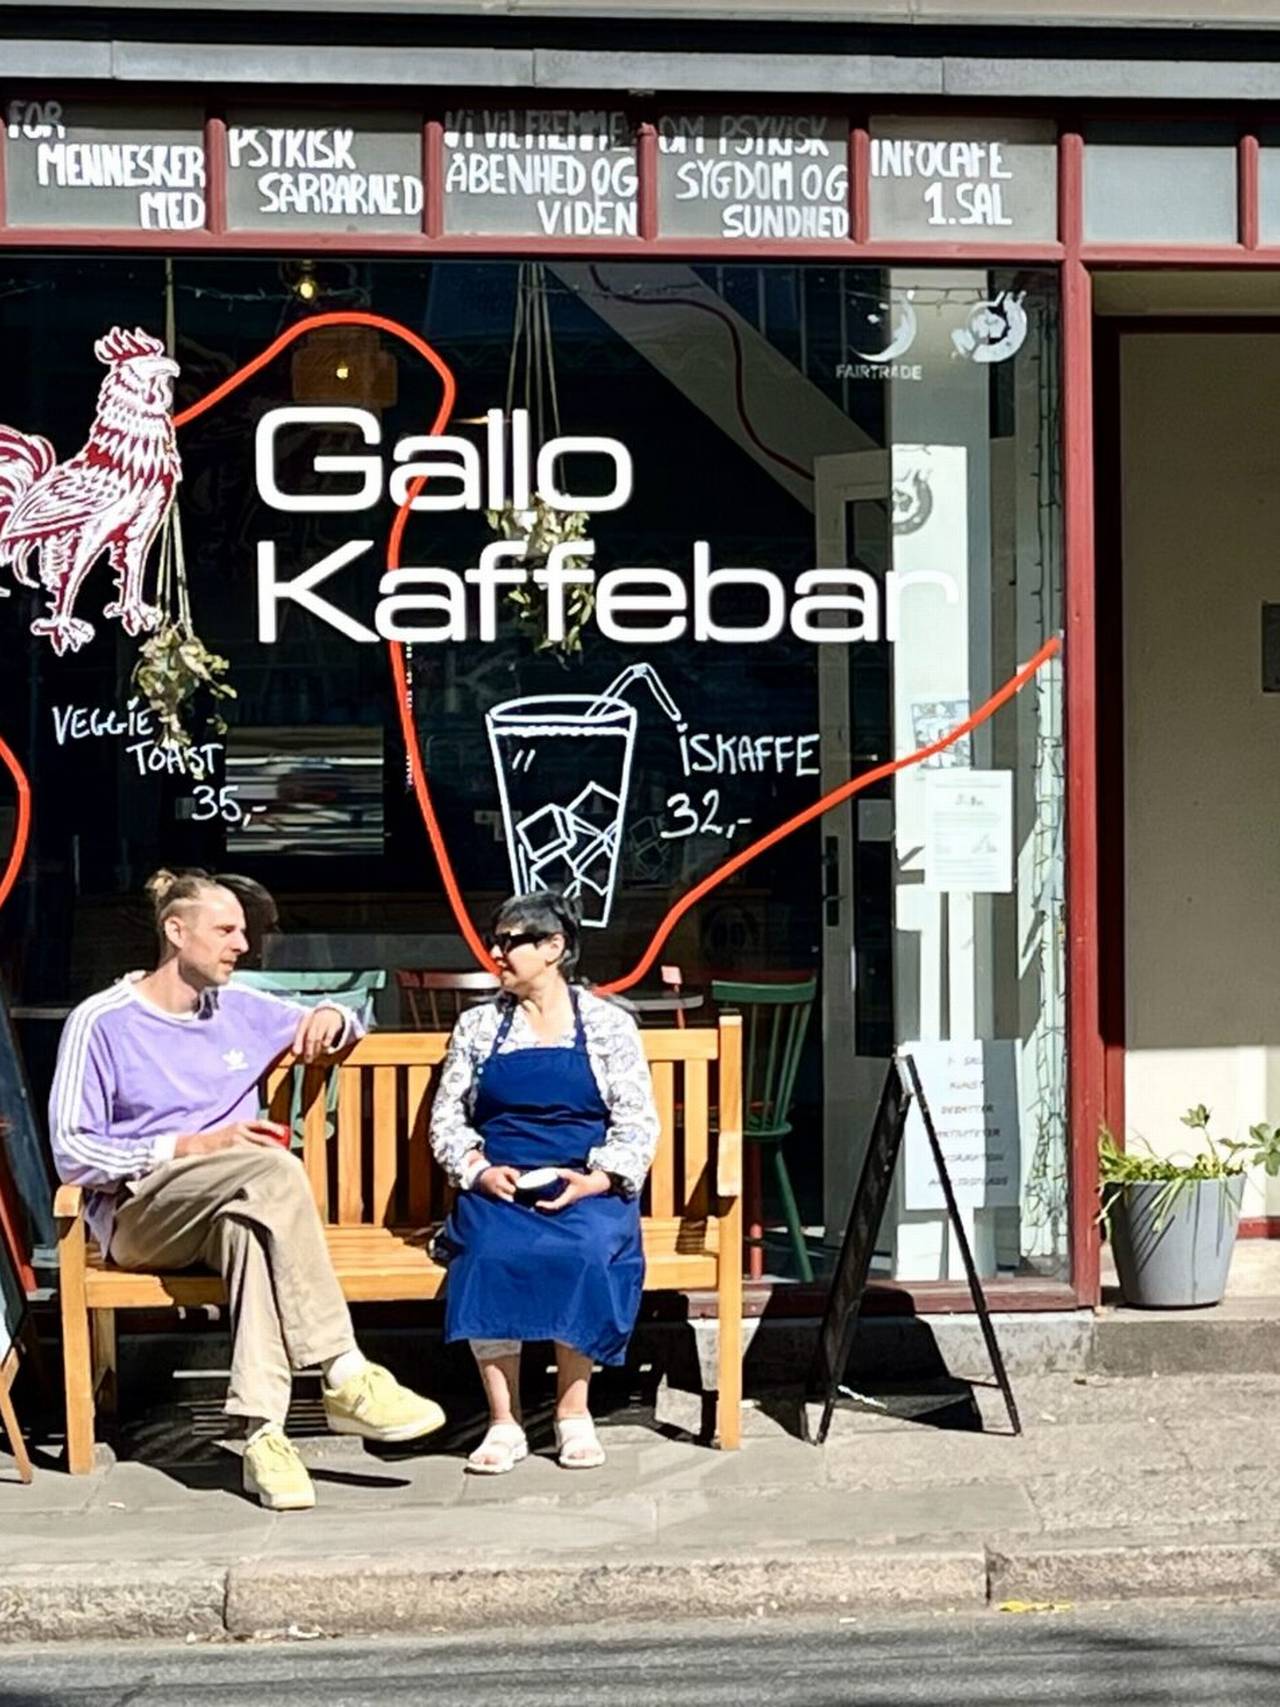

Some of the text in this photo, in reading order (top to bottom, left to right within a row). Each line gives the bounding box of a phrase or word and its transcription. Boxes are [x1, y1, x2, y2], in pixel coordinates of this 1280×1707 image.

[8, 101, 66, 139] FOR
[38, 143, 206, 188] MENNESKER
[446, 152, 639, 197] ÅBENHED OG
[675, 159, 849, 201] SYGDOM OG
[140, 192, 206, 230] MED
[537, 200, 638, 236] VIDEN
[722, 204, 850, 238] SUNDHED
[836, 364, 923, 381] FAIRTRADE
[255, 408, 633, 512] Gallo
[257, 540, 961, 643] Kaffebar
[52, 696, 155, 745] VEGGIE
[126, 742, 224, 776] TOAST
[677, 722, 820, 777] ISKAFFE
